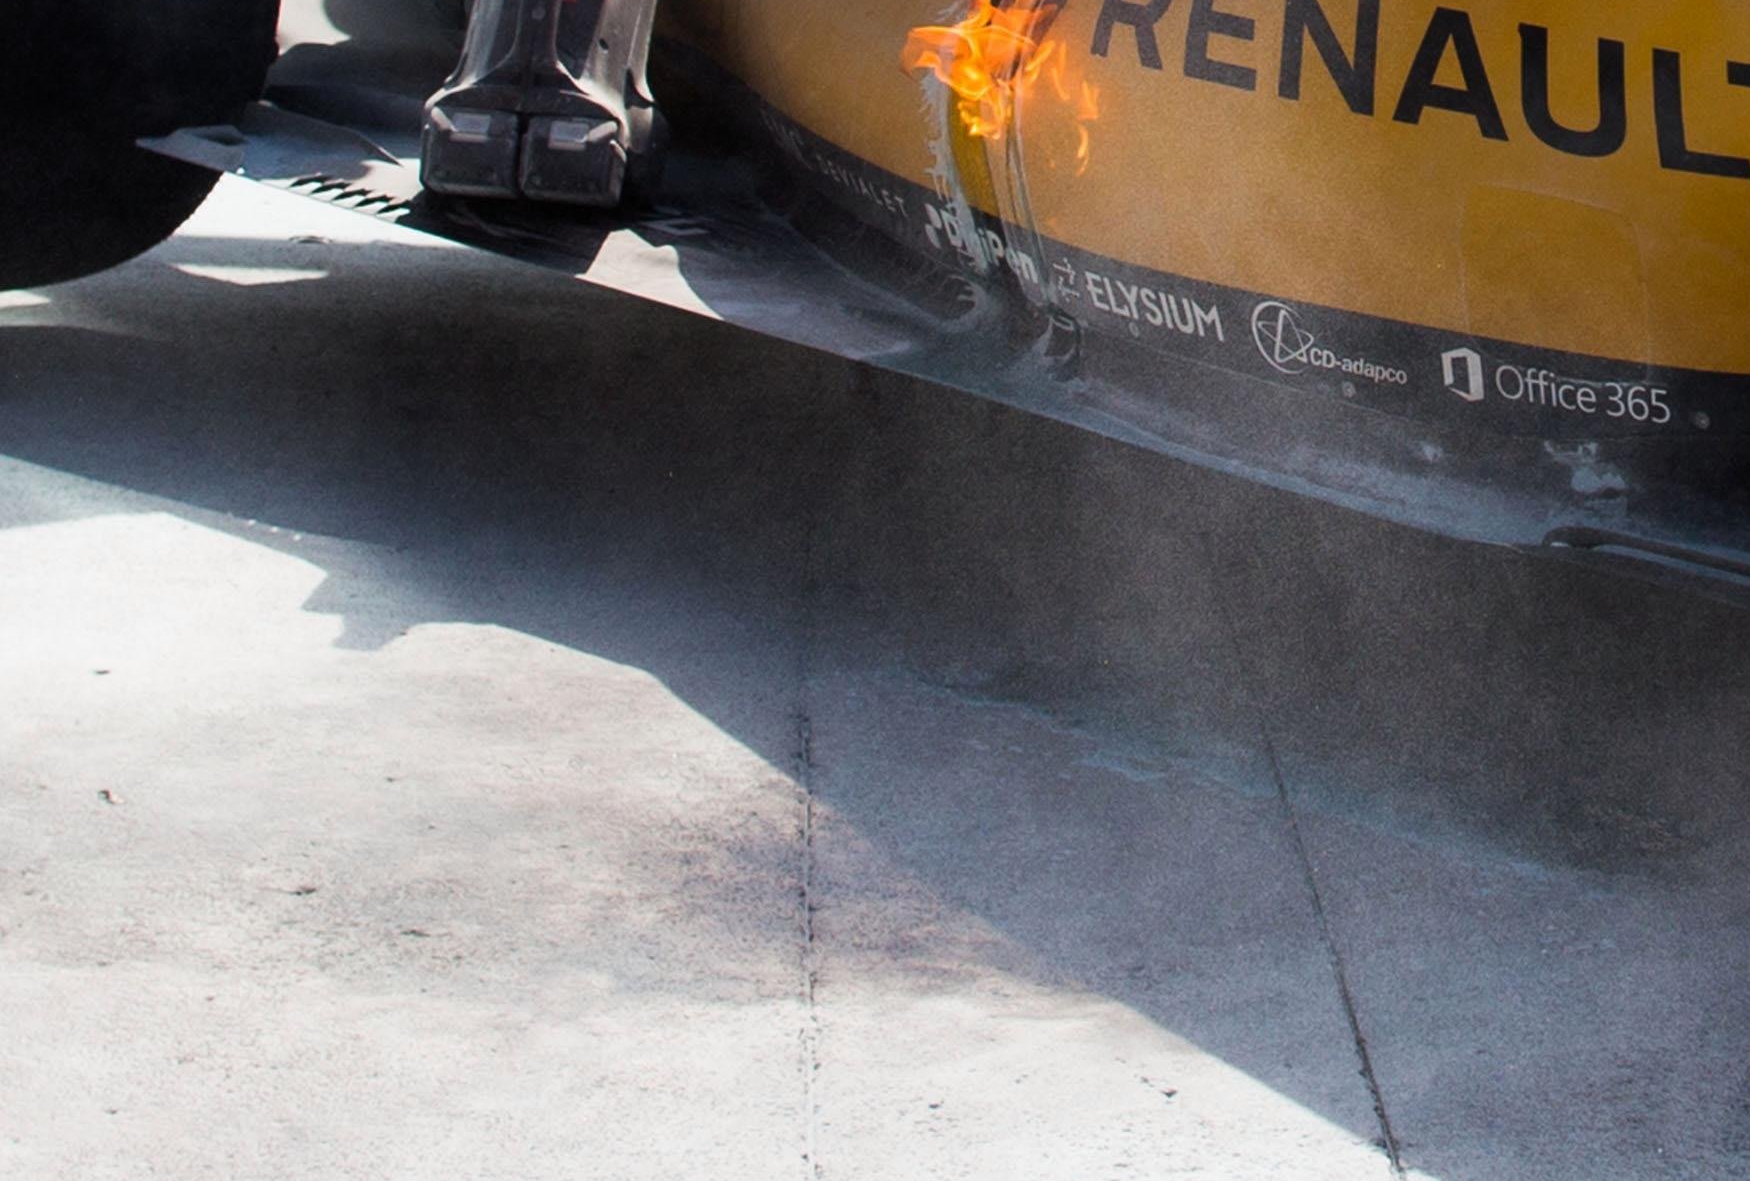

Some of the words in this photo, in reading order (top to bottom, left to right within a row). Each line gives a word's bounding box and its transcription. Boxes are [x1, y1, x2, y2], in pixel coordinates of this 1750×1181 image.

[1085, 271, 1224, 343] ELYSIUM
[1309, 347, 1407, 385] CD-adapco
[1496, 364, 1597, 414] Office
[1604, 382, 1671, 423] 365
